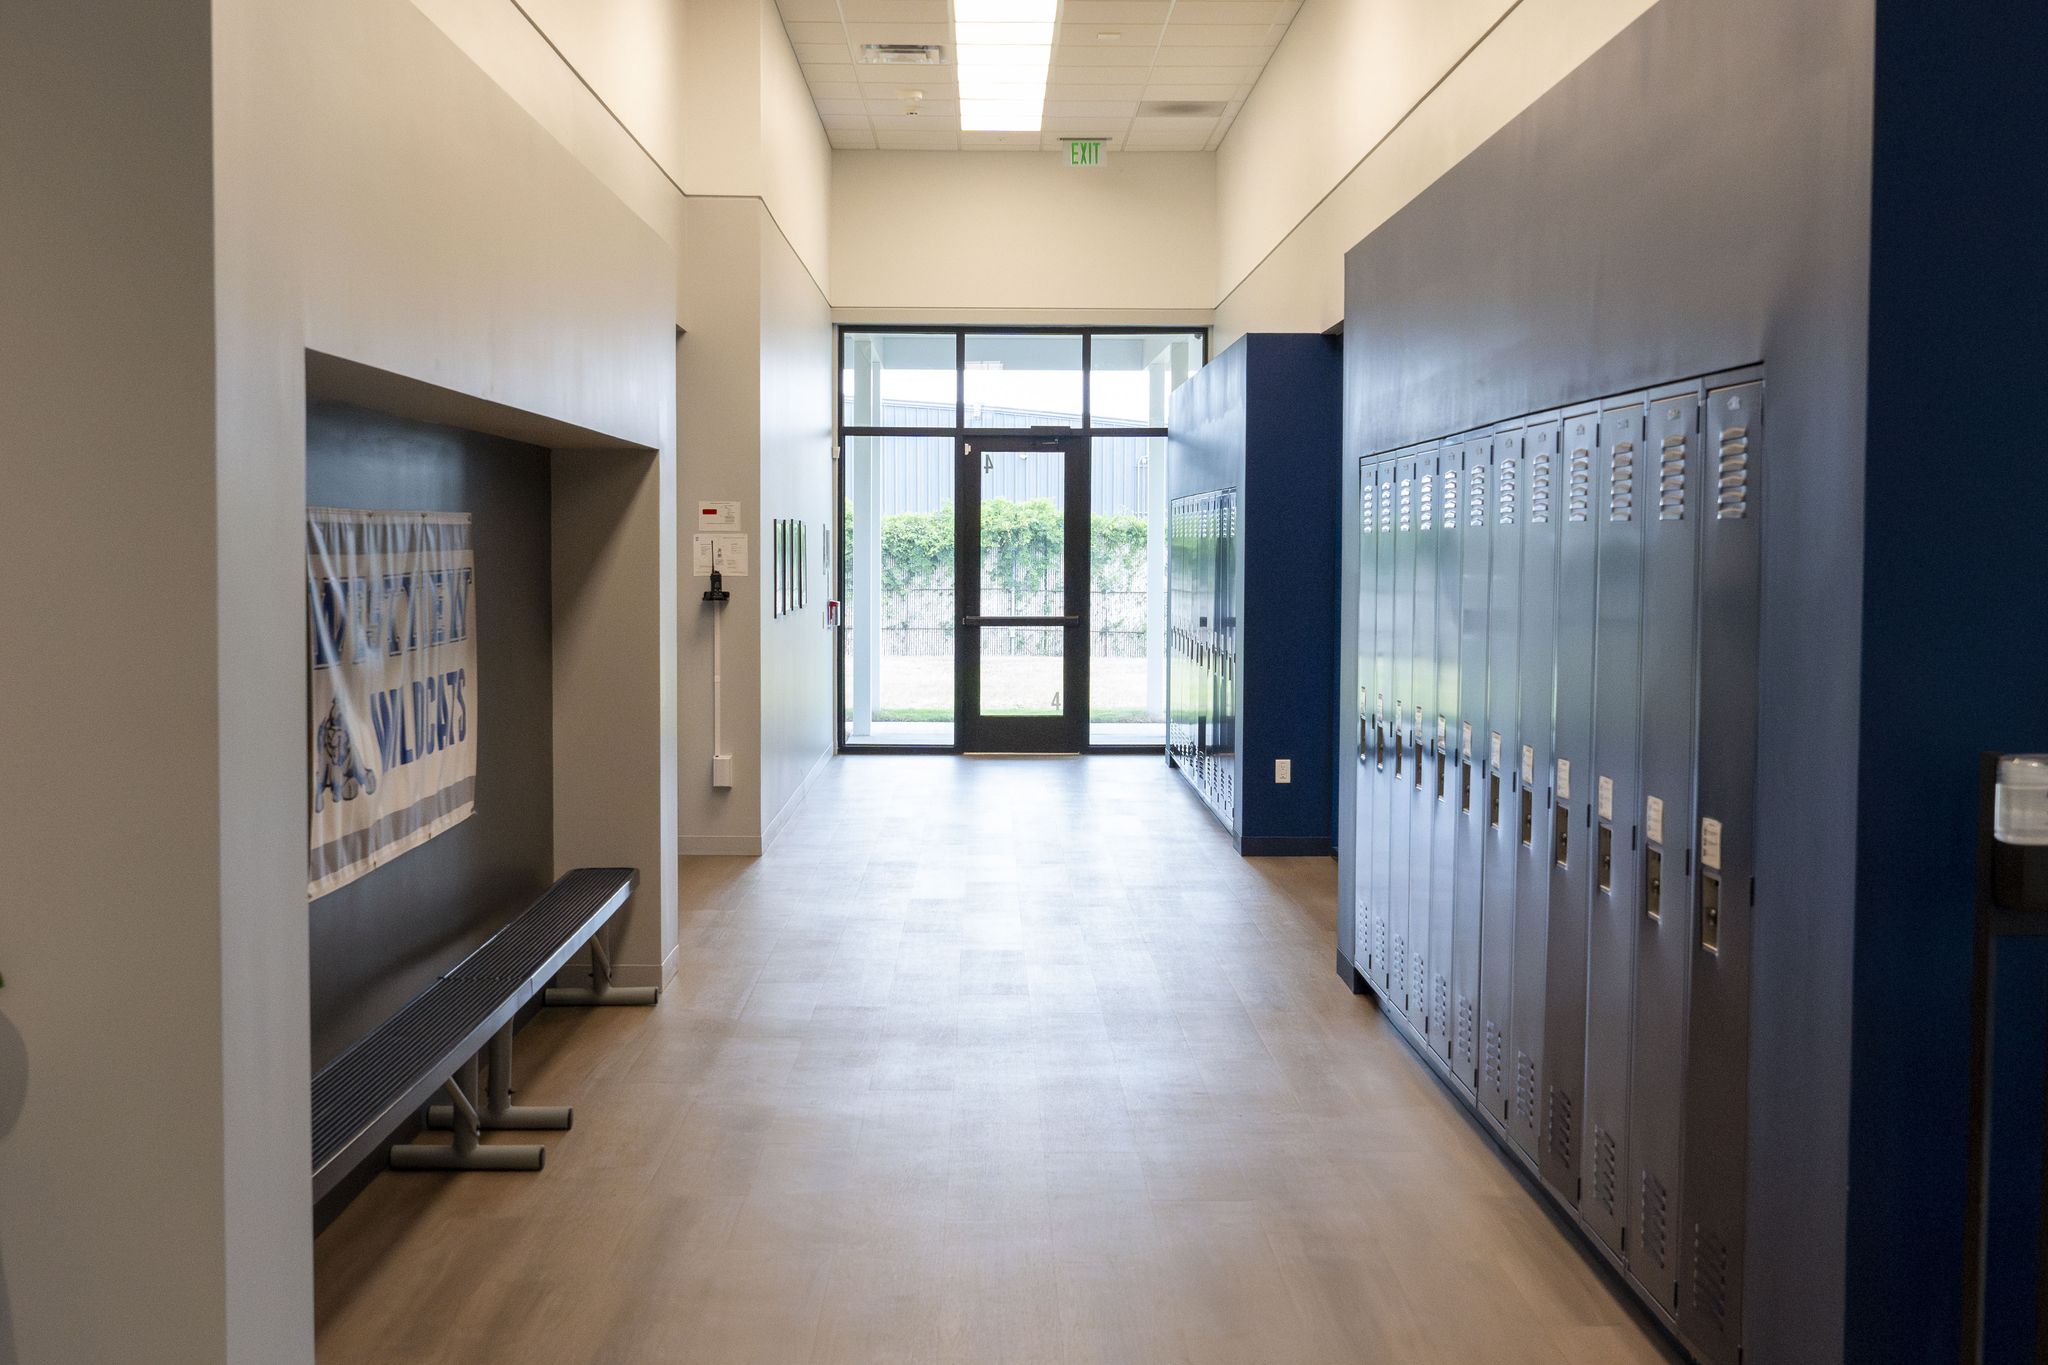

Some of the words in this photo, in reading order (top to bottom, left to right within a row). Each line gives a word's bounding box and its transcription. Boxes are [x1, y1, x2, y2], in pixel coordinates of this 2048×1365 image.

[1071, 142, 1101, 165] EXIT
[1050, 691, 1062, 711] 4
[370, 668, 467, 774] WILDCATS
